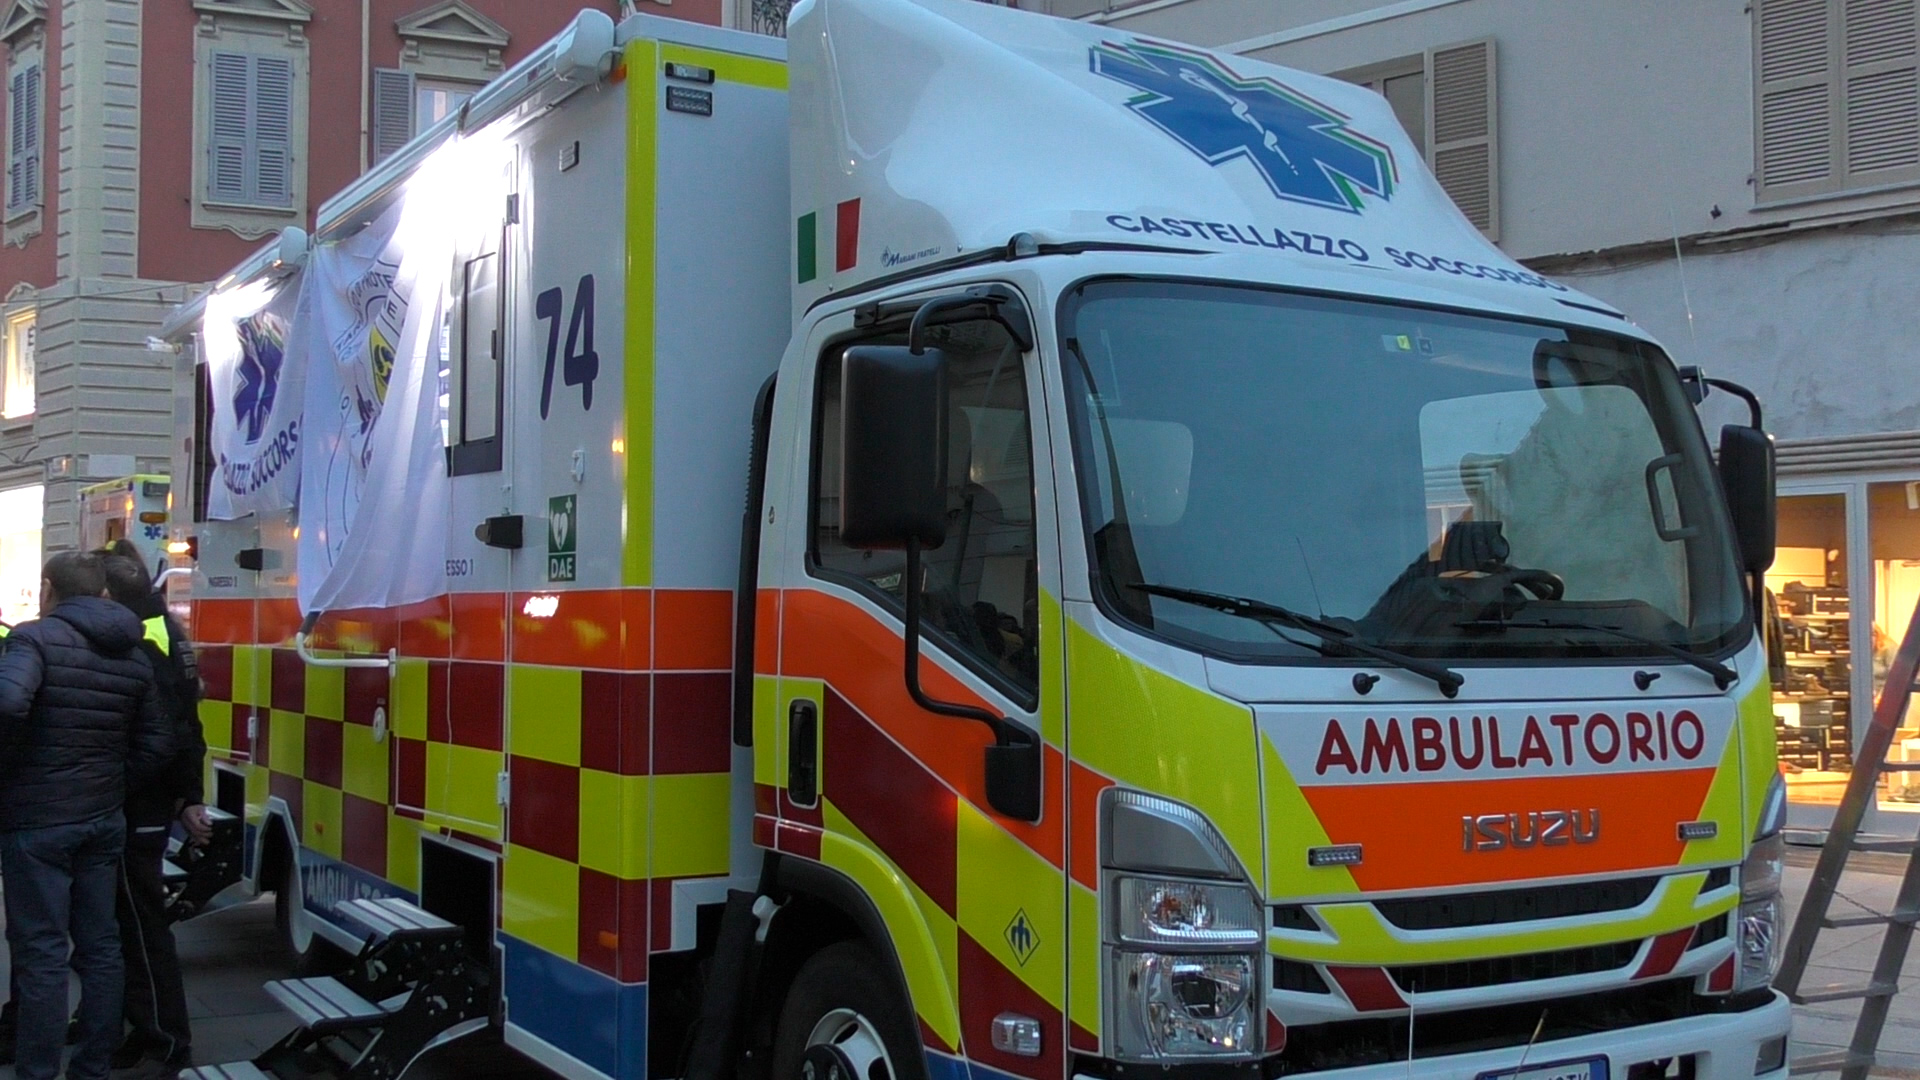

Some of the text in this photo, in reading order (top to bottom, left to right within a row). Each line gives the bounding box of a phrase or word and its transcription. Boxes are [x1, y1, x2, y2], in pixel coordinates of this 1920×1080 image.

[1106, 214, 1569, 292] CASTELLAZZO SOCCORSO
[536, 273, 600, 421] 74
[446, 560, 468, 577] ESSO
[551, 556, 573, 579] DAE
[1315, 709, 1705, 776] AMBULATORIO
[1461, 808, 1600, 852] ISUZU
